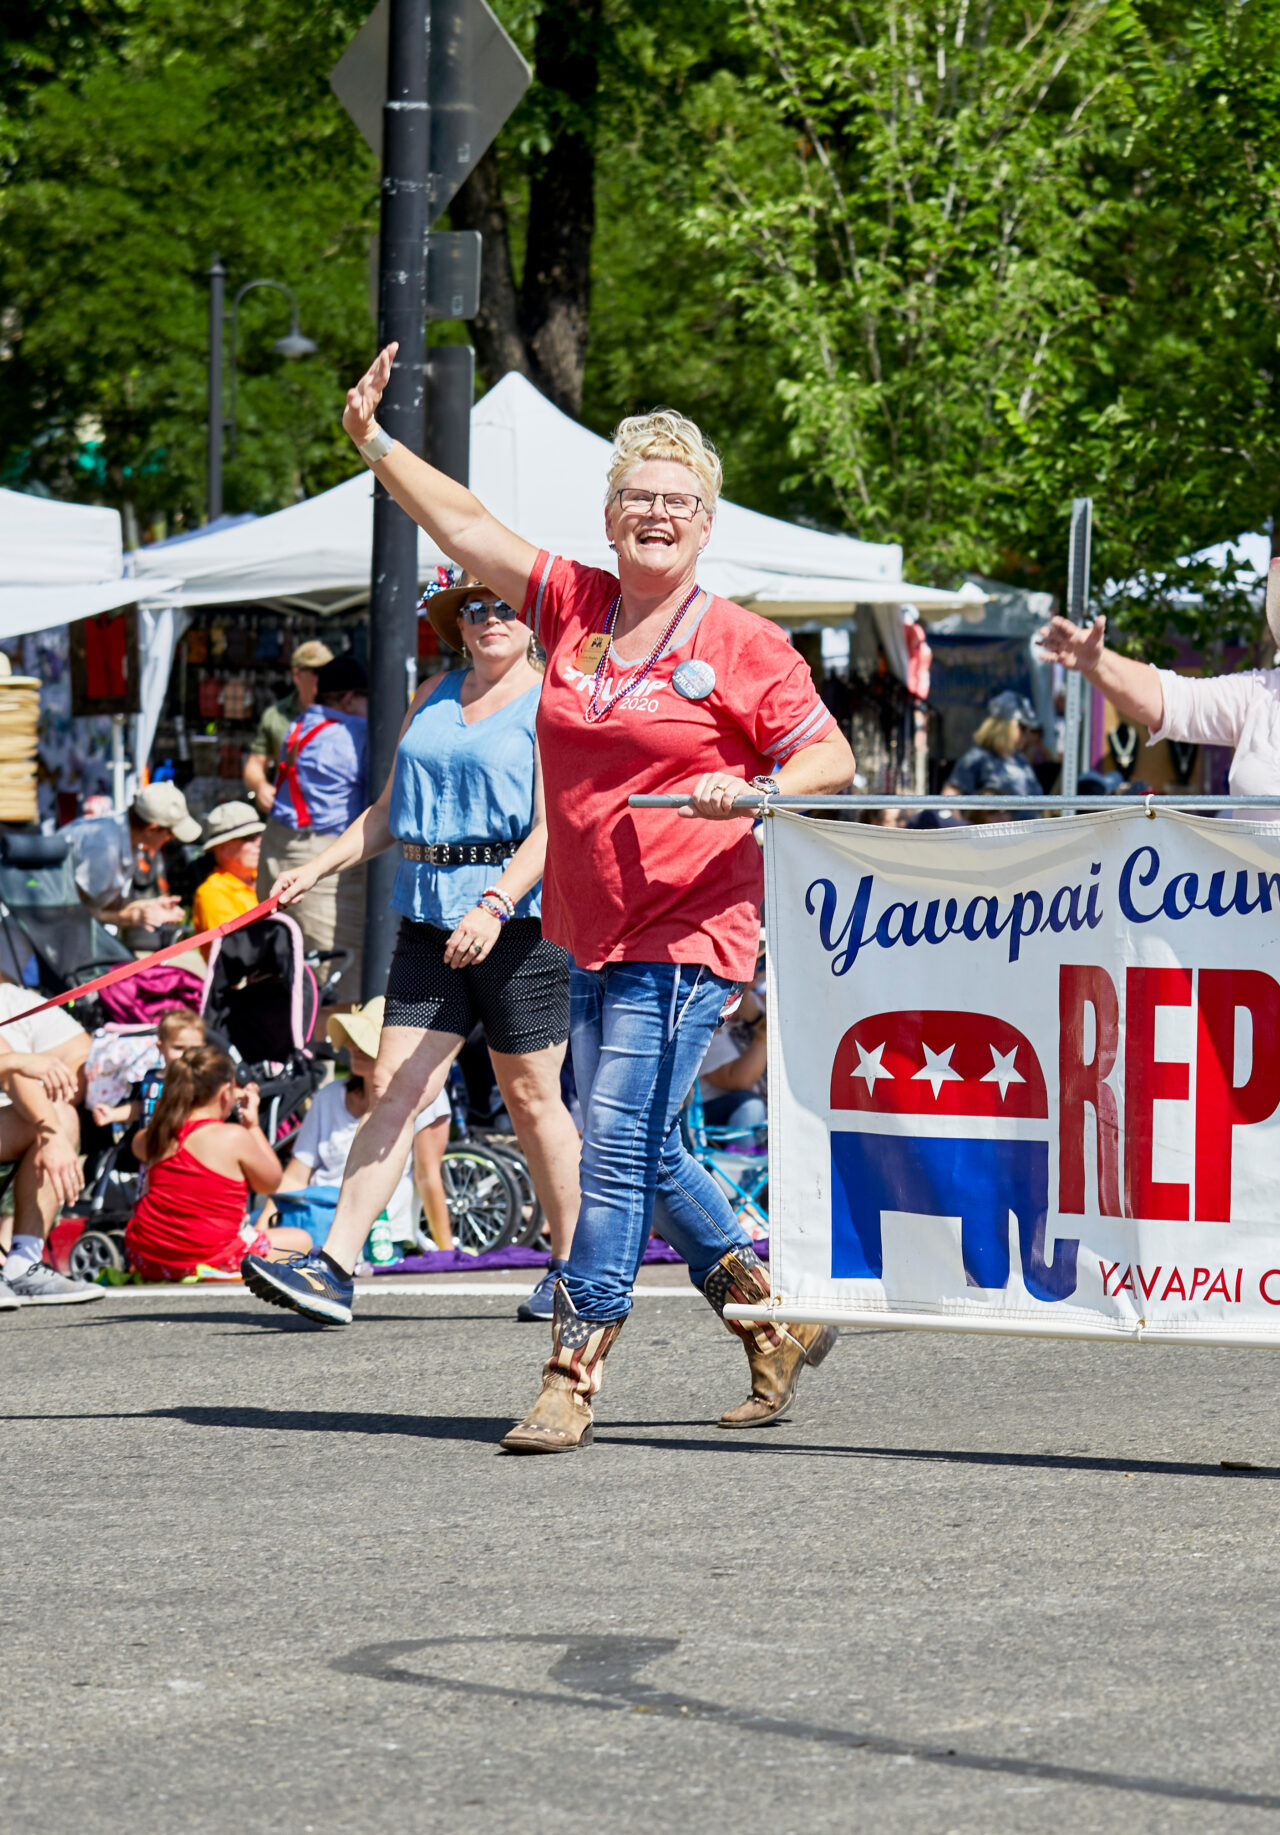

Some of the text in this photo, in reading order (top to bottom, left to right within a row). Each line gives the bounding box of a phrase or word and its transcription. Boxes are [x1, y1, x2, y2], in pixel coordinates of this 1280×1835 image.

[618, 697, 659, 713] 2020
[806, 862, 1102, 977] Yavapai
[1098, 1261, 1243, 1303] YAVAPAI
